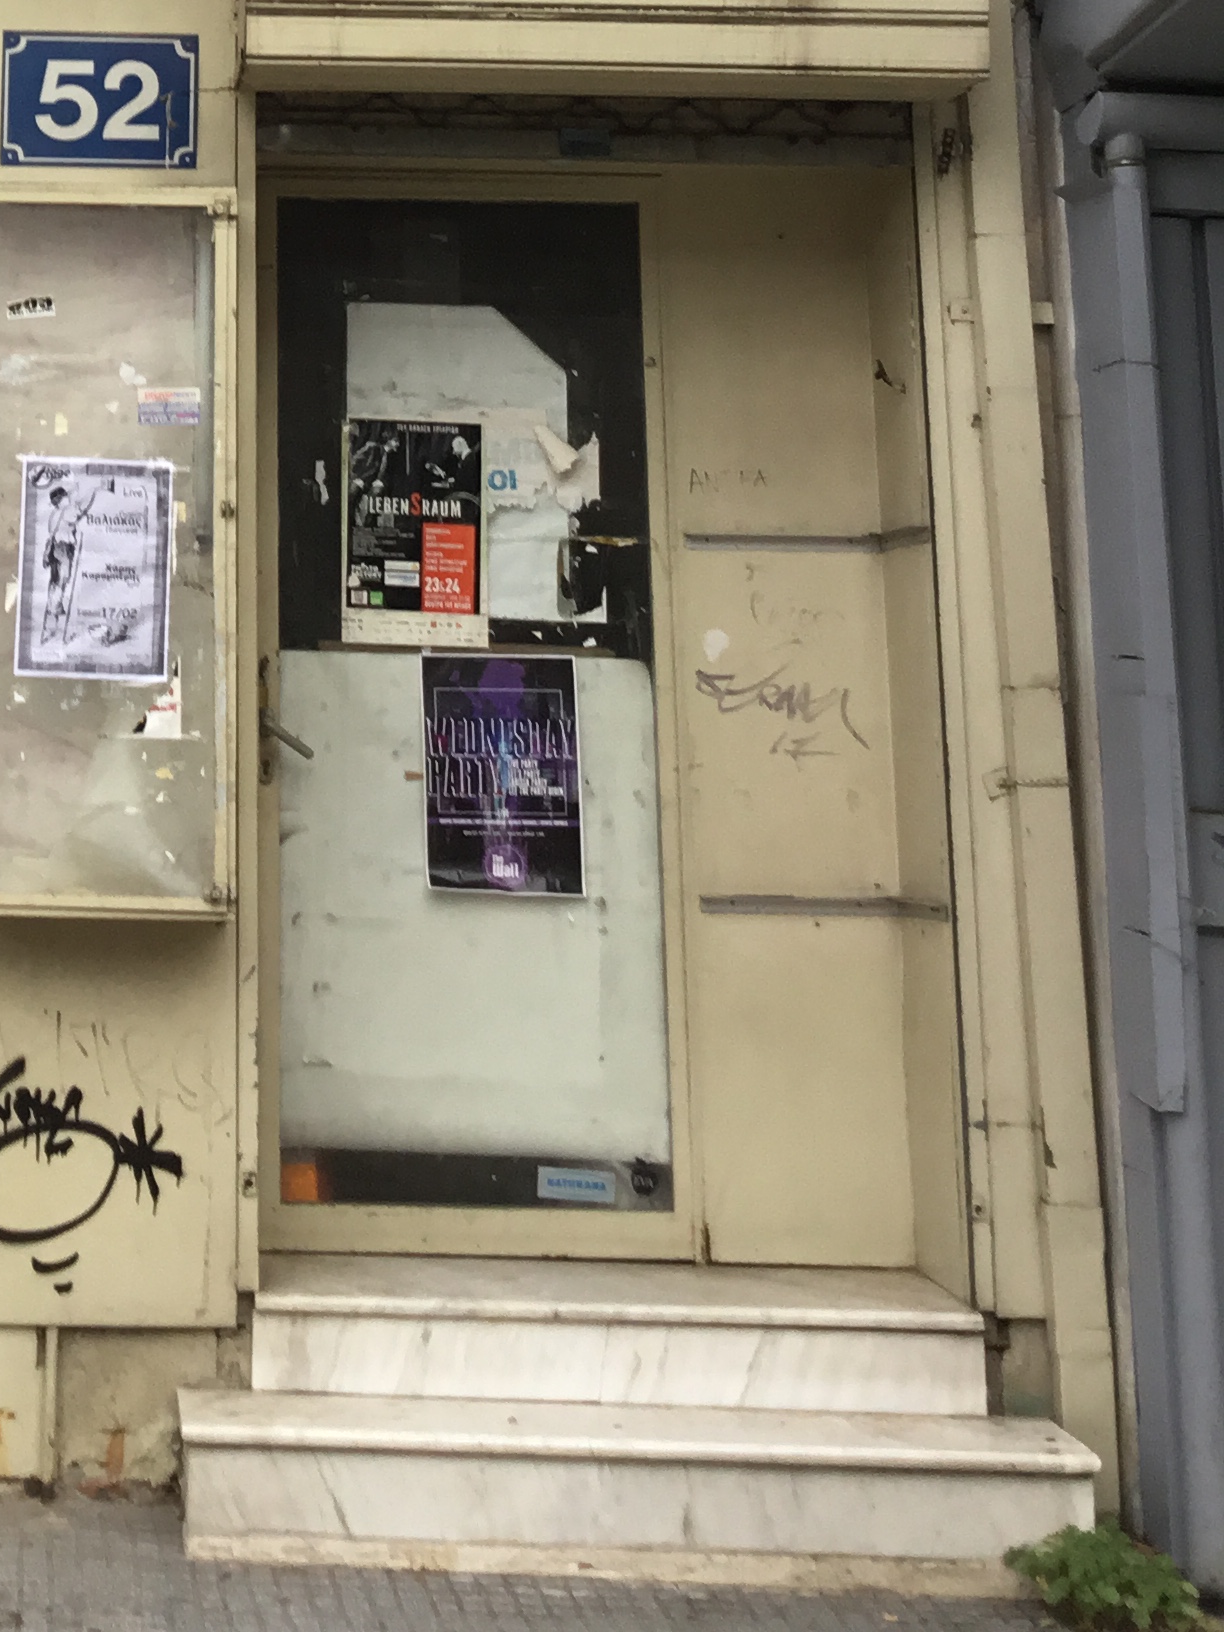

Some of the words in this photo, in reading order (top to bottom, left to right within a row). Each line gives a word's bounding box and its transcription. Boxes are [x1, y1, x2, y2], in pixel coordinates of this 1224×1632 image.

[34, 58, 161, 142] 52
[368, 491, 462, 518] LEBENSRAUM
[426, 716, 575, 760] WEDNESDAY
[426, 755, 505, 799] PARTY
[492, 862, 520, 879] Wall
